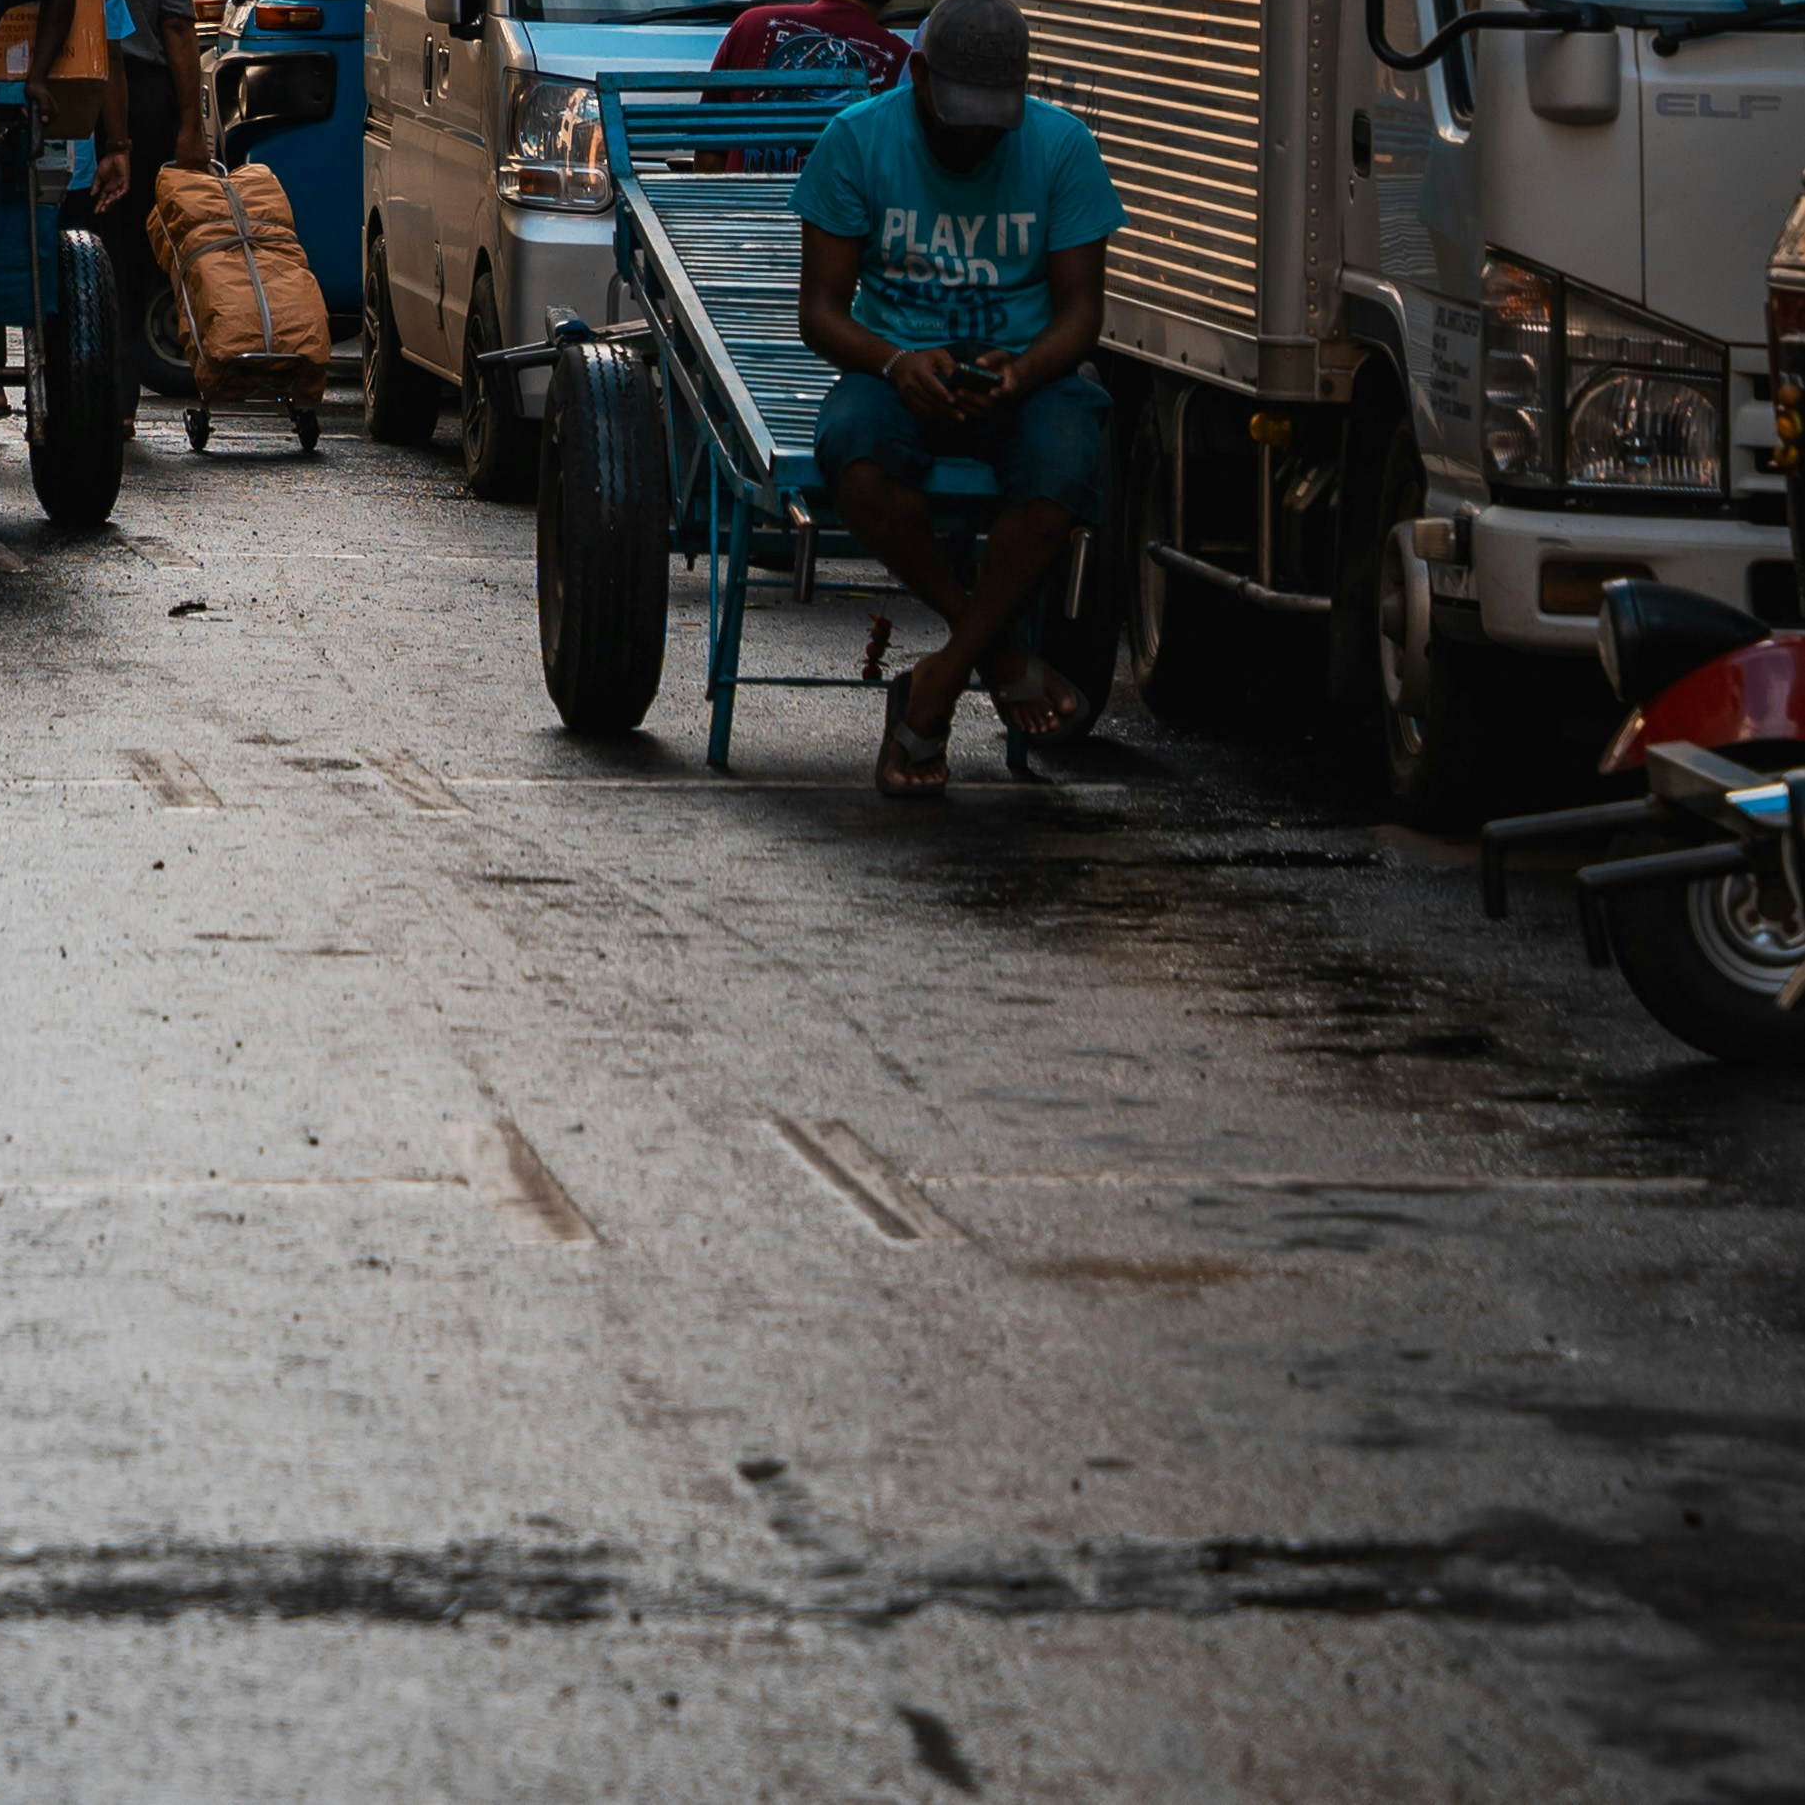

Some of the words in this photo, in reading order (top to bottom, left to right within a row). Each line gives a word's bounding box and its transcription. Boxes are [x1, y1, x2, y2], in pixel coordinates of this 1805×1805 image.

[1656, 92, 1782, 119] ELF
[881, 207, 986, 258] PLAY
[996, 212, 1037, 257] IT
